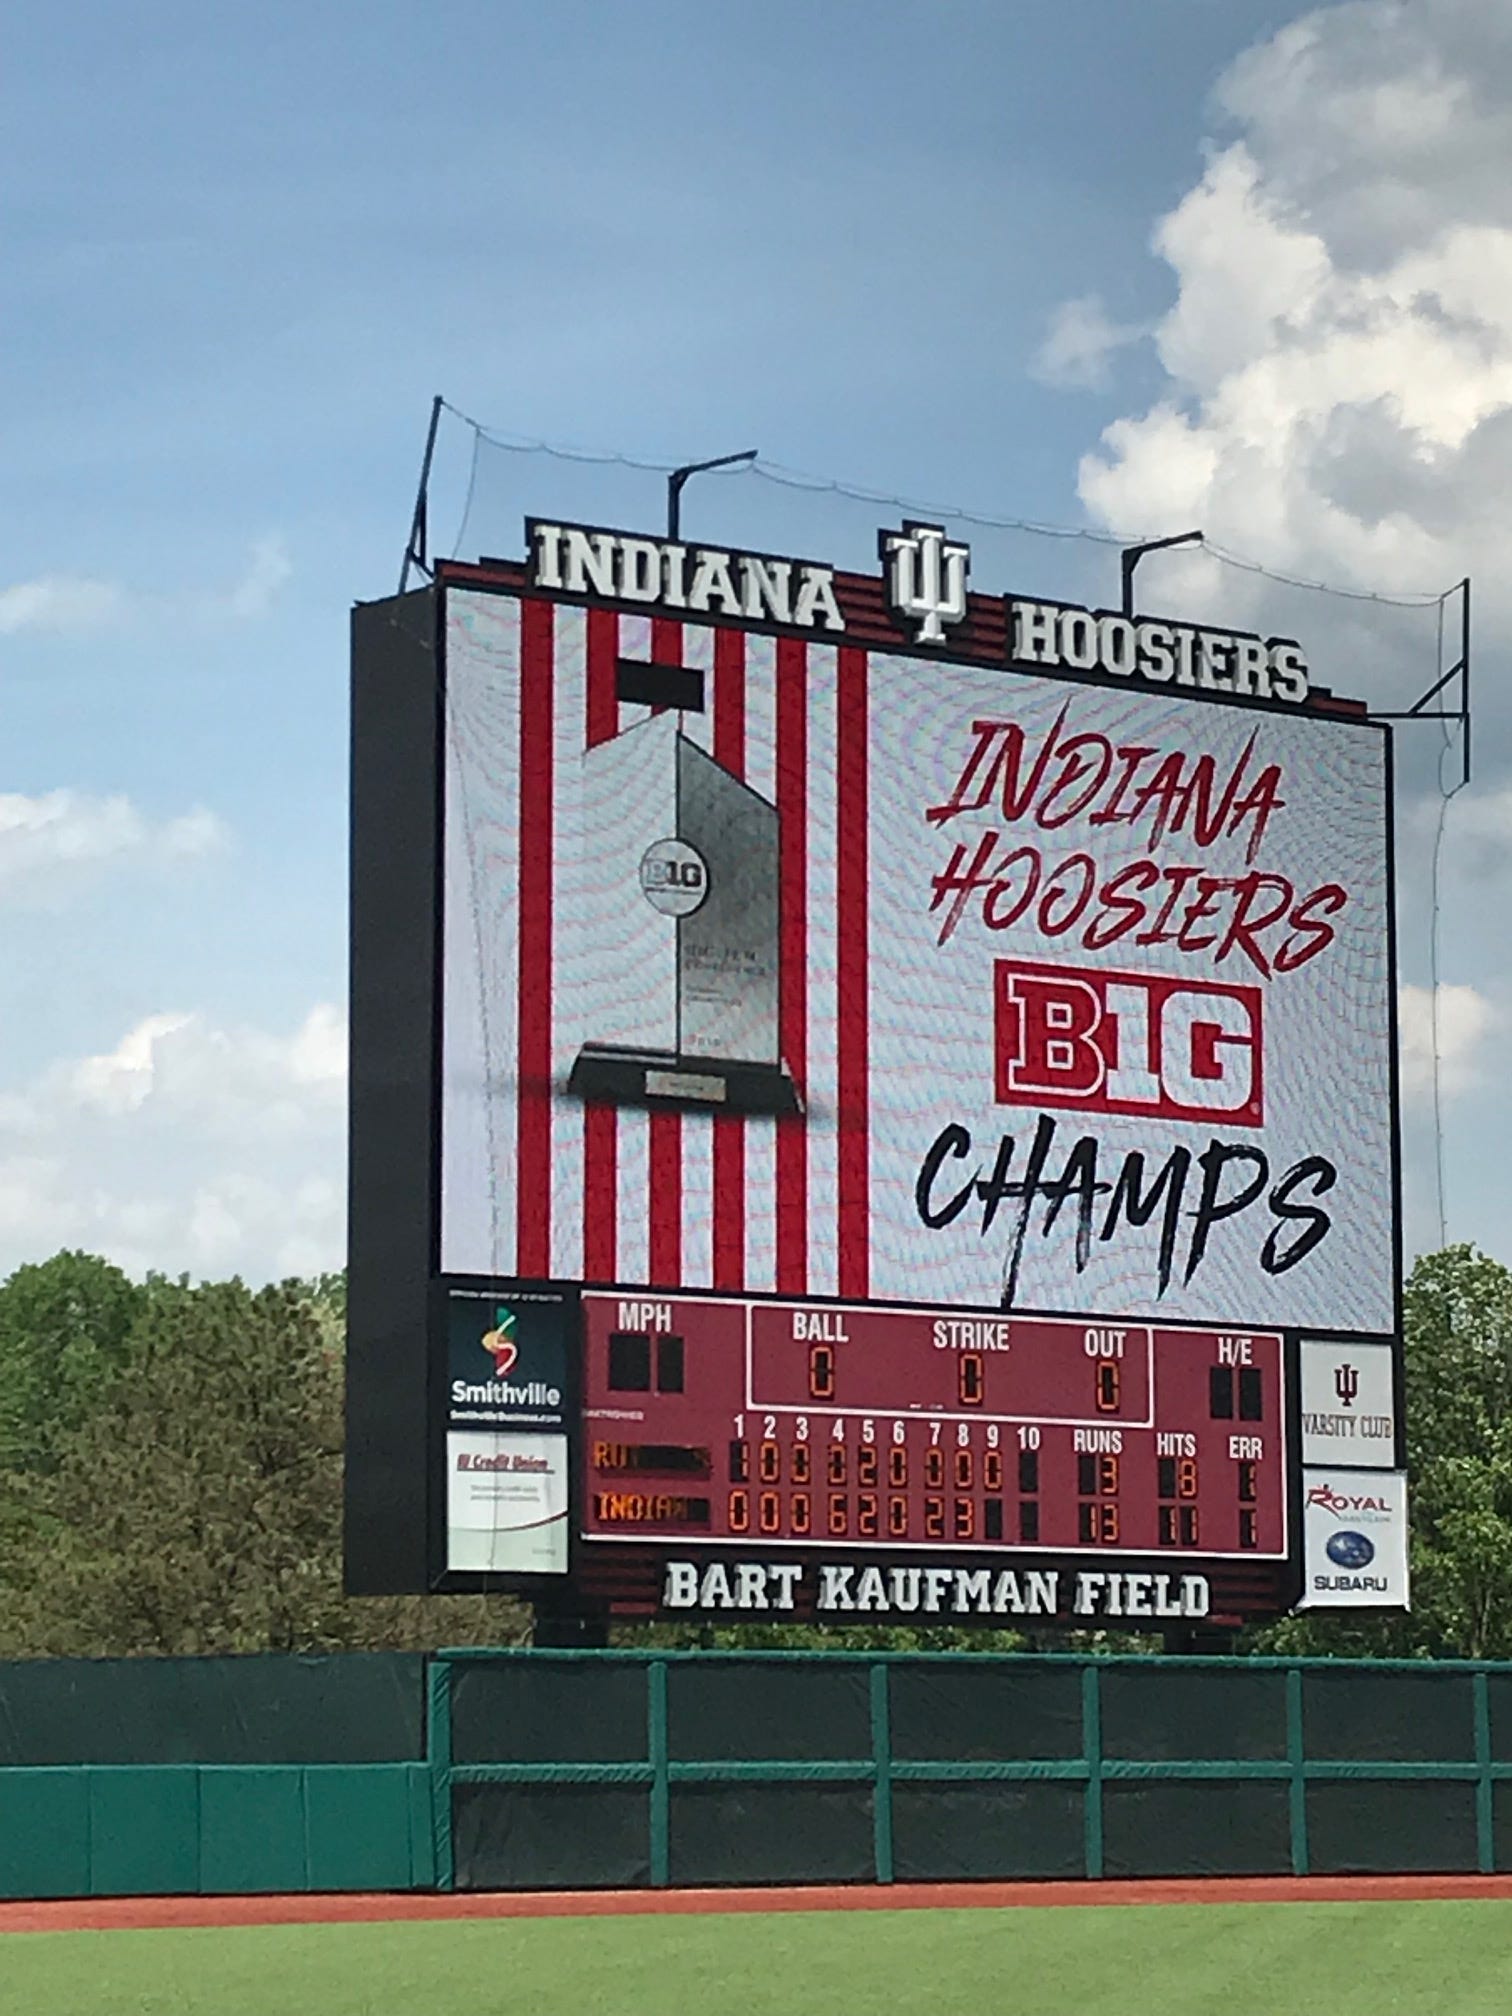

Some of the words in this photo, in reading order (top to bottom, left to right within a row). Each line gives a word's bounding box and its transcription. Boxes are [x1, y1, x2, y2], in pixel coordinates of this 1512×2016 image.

[534, 525, 845, 630] INDIANA
[1012, 602, 1308, 702] HOOSIERS
[926, 696, 1285, 865] INDIANA
[929, 831, 1347, 980] HOOSIERS
[916, 1114, 1337, 1308] CHAMPS
[619, 1302, 671, 1332] MPH
[793, 1312, 849, 1341] BALL
[933, 1320, 1009, 1350] STRIKE
[1084, 1329, 1126, 1358] OUT
[1218, 1338, 1252, 1366] H/E
[451, 1380, 560, 1406] Smithville
[811, 1346, 833, 1396] 0
[960, 1353, 982, 1402] 0
[1097, 1361, 1119, 1410] 0
[734, 1414, 744, 1438] 1
[764, 1415, 776, 1438] 2
[796, 1416, 808, 1440] 3
[832, 1418, 844, 1441] 4
[862, 1419, 874, 1443] 5
[893, 1420, 905, 1444] 6
[929, 1422, 941, 1445] 7
[958, 1423, 970, 1446] 8
[987, 1424, 999, 1448] 9
[1017, 1427, 1040, 1450] 10
[1073, 1429, 1122, 1454] RUNS
[1157, 1433, 1196, 1457] HITS
[1229, 1437, 1262, 1460] ERR
[1302, 1412, 1355, 1437] VARSITY
[1360, 1416, 1392, 1438] CLUB
[474, 1454, 509, 1469] Credit
[760, 1441, 779, 1482] 0
[792, 1443, 809, 1482] 0
[859, 1446, 877, 1485] 2
[889, 1447, 907, 1486] 0
[925, 1449, 943, 1487] 0
[955, 1450, 973, 1489] 0
[984, 1451, 1002, 1490] 0
[1102, 1457, 1118, 1494] 3
[1178, 1459, 1197, 1497] 8
[598, 1490, 690, 1521] INDIAN
[729, 1490, 748, 1531] 0
[760, 1491, 779, 1532] 0
[791, 1493, 809, 1532] 0
[829, 1494, 847, 1534] 6
[859, 1495, 877, 1534] 2
[889, 1496, 907, 1535] 0
[925, 1498, 943, 1537] 2
[955, 1498, 974, 1538] 3
[1090, 1504, 1118, 1541] 13
[1306, 1488, 1392, 1521] ROYAL
[663, 1562, 802, 1609] BART
[817, 1565, 1058, 1614] KAUFMAN
[1073, 1572, 1208, 1617] FIELD
[1314, 1575, 1388, 1592] SUBARU
